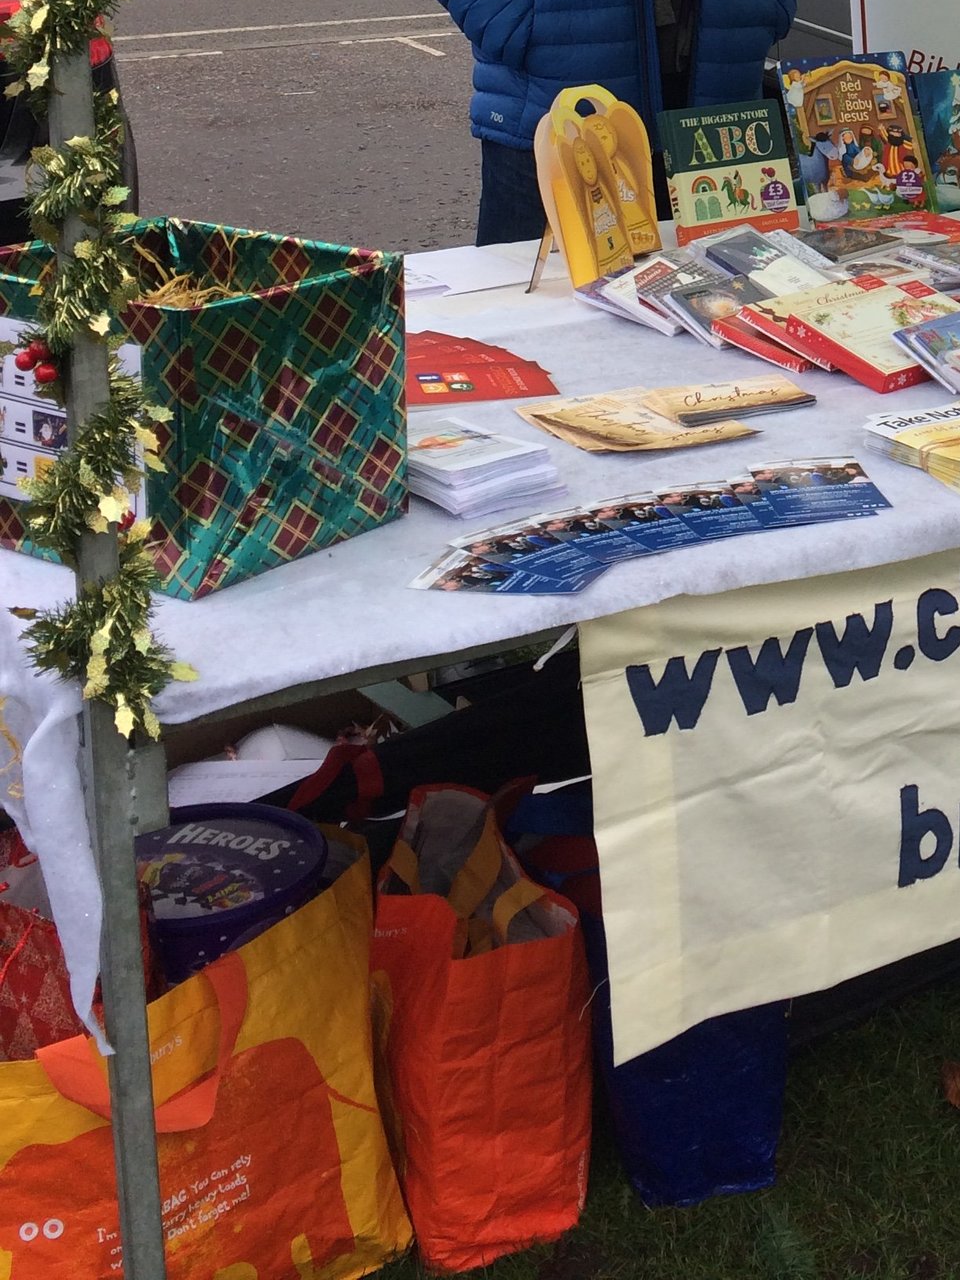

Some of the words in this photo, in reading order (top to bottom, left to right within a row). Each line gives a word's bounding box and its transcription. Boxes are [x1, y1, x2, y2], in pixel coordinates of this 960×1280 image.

[839, 80, 862, 92] Bed
[847, 92, 858, 100] for
[845, 99, 872, 112] Baby
[490, 110, 504, 123] 700
[680, 118, 700, 128] THE
[701, 112, 740, 126] BIGGEST
[740, 108, 769, 120] STORY
[839, 110, 869, 123] Jesus
[688, 121, 773, 166] ABC
[901, 172, 916, 183] £2
[768, 184, 783, 195] £3
[684, 385, 781, 408] Christmas
[876, 414, 927, 431] Take
[167, 823, 291, 861] HEROES
[97, 1227, 117, 1243] I'm
[190, 1177, 209, 1194] You
[210, 1169, 228, 1180] can
[230, 1154, 252, 1172] rely
[188, 1189, 217, 1212] heavy
[218, 1173, 248, 1193] loads
[167, 1216, 197, 1240] Don't
[198, 1200, 231, 1222] forget
[232, 1184, 251, 1206] me!
